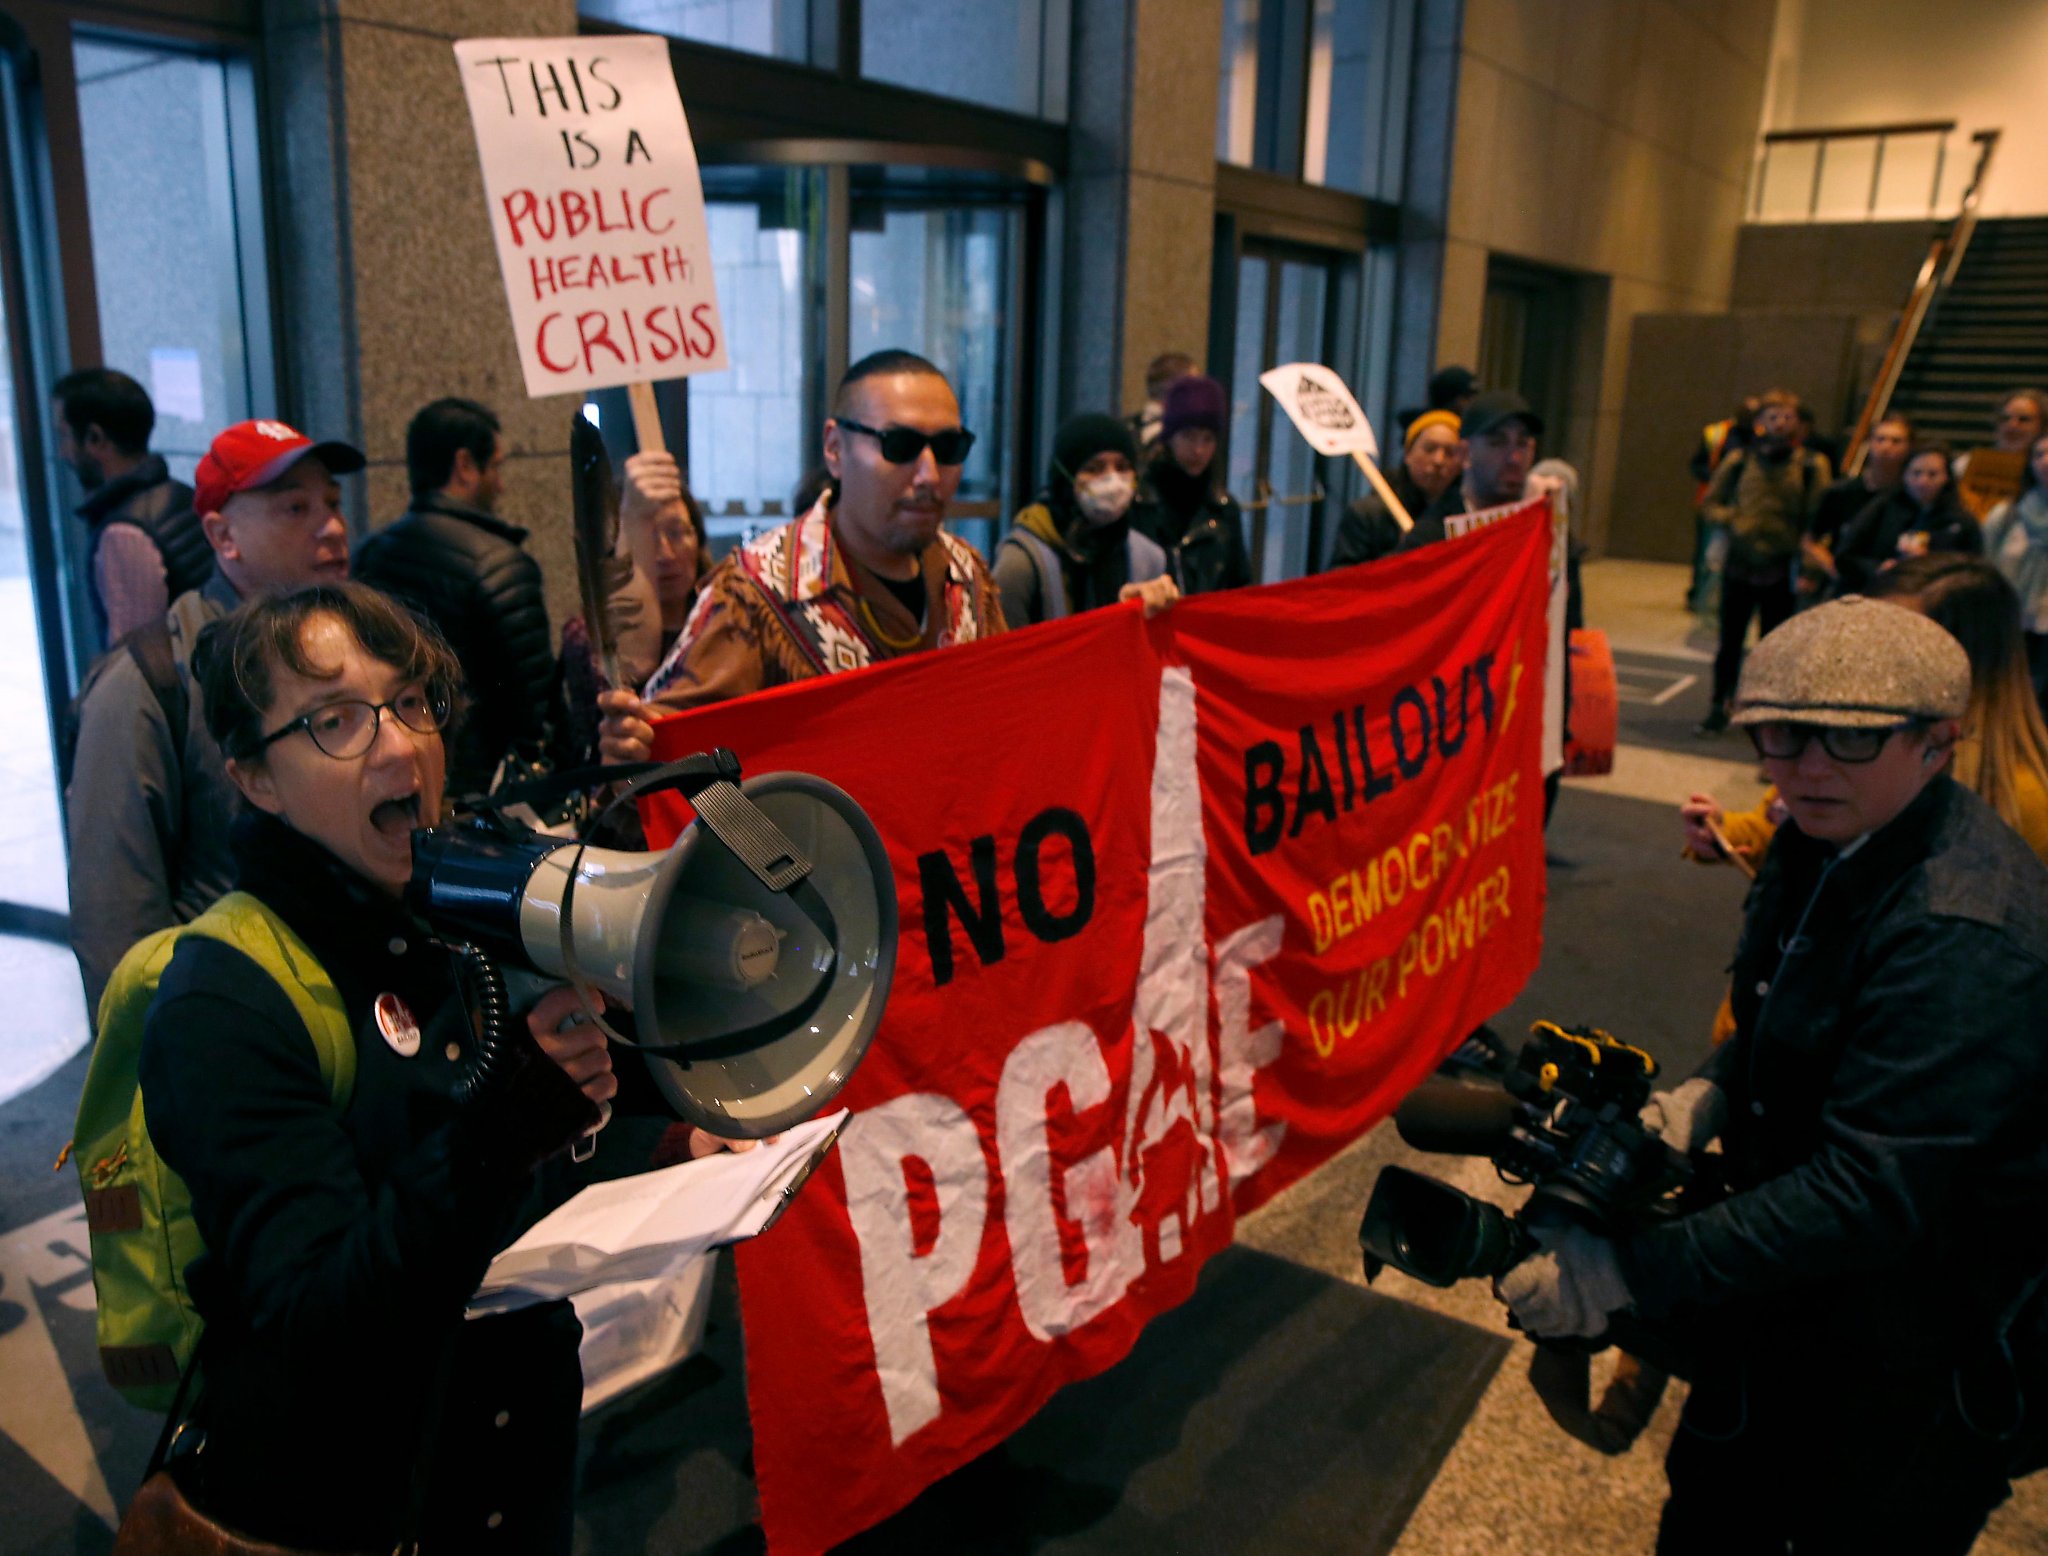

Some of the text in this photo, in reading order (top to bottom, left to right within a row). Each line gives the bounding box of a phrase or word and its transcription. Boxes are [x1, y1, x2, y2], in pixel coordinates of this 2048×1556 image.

[474, 56, 622, 117] THIS
[561, 129, 651, 170] IS A
[503, 188, 675, 247] PUBLIC
[529, 246, 689, 301] HEALTH
[536, 304, 716, 375] CRISIS
[1244, 653, 1495, 856] BAILOUT
[918, 807, 1096, 986] NO
[1308, 866, 1511, 1058] OUR POWER
